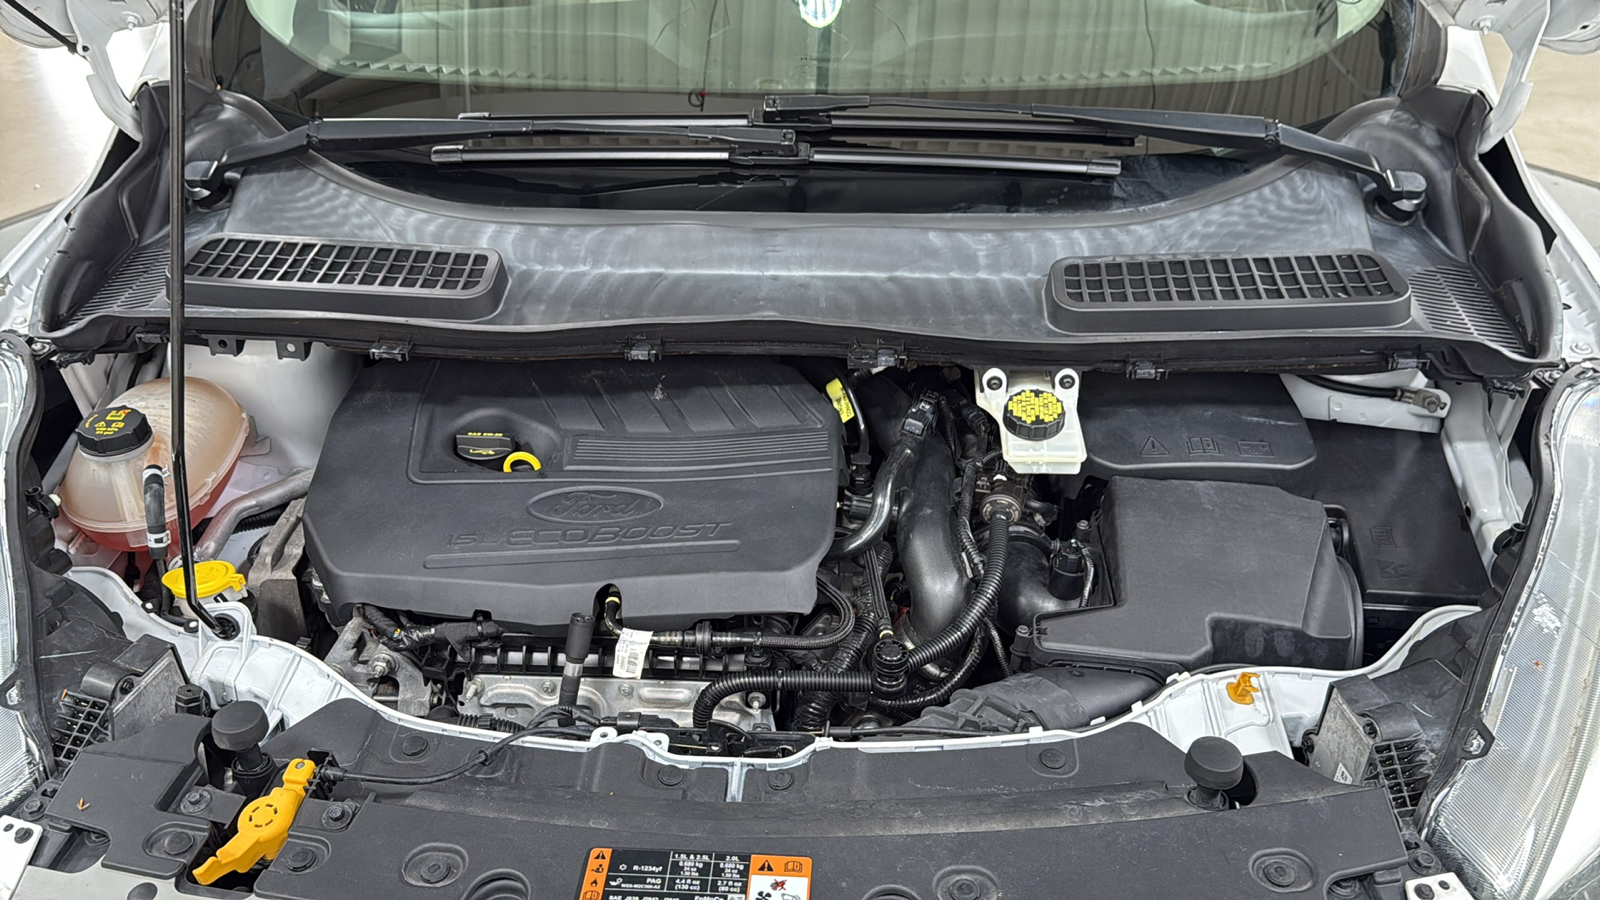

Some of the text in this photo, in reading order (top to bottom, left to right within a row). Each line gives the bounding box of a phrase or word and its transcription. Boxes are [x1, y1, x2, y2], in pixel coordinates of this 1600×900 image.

[553, 492, 638, 519] Ford
[506, 522, 732, 548] ECOBOOST
[633, 865, 663, 873] R-1234yf
